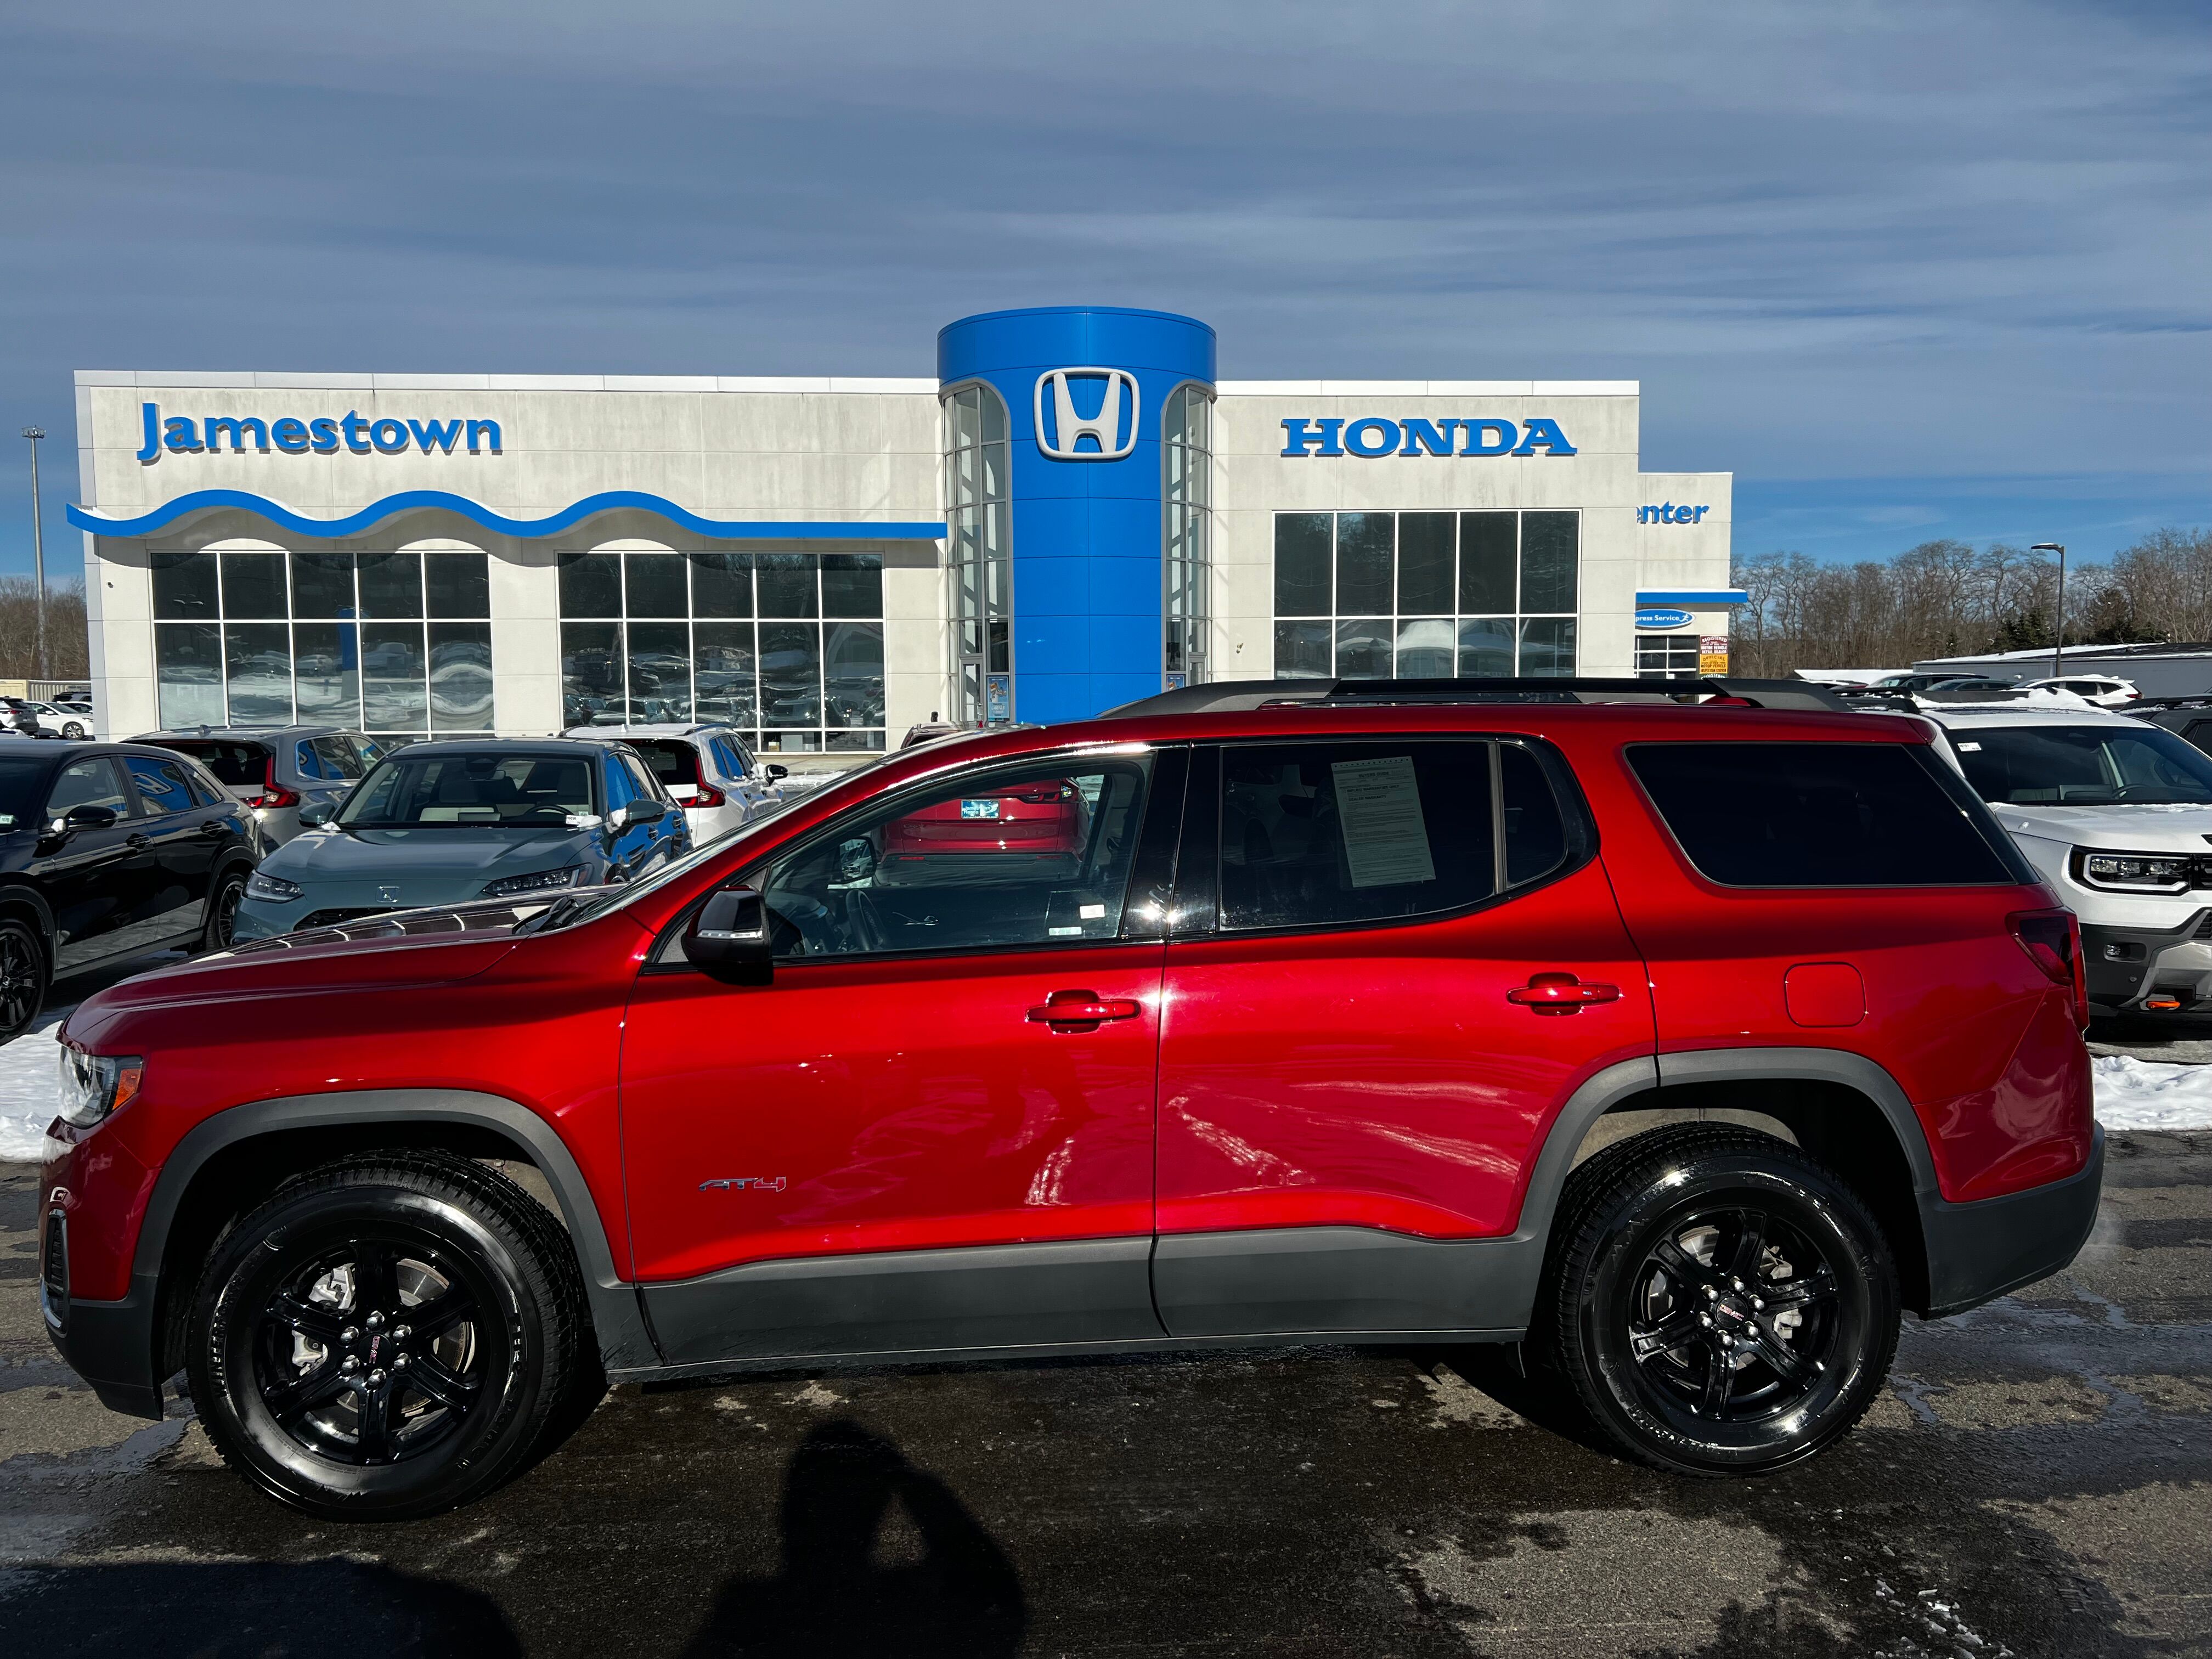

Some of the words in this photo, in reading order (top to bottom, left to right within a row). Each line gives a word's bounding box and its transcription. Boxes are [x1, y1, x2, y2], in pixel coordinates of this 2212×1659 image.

[137, 403, 502, 464] Jamestown
[1280, 417, 1577, 458] HONDA
[699, 1176, 786, 1192] AT4
[1719, 1304, 1745, 1321] GMC
[369, 1336, 380, 1364] GMC
